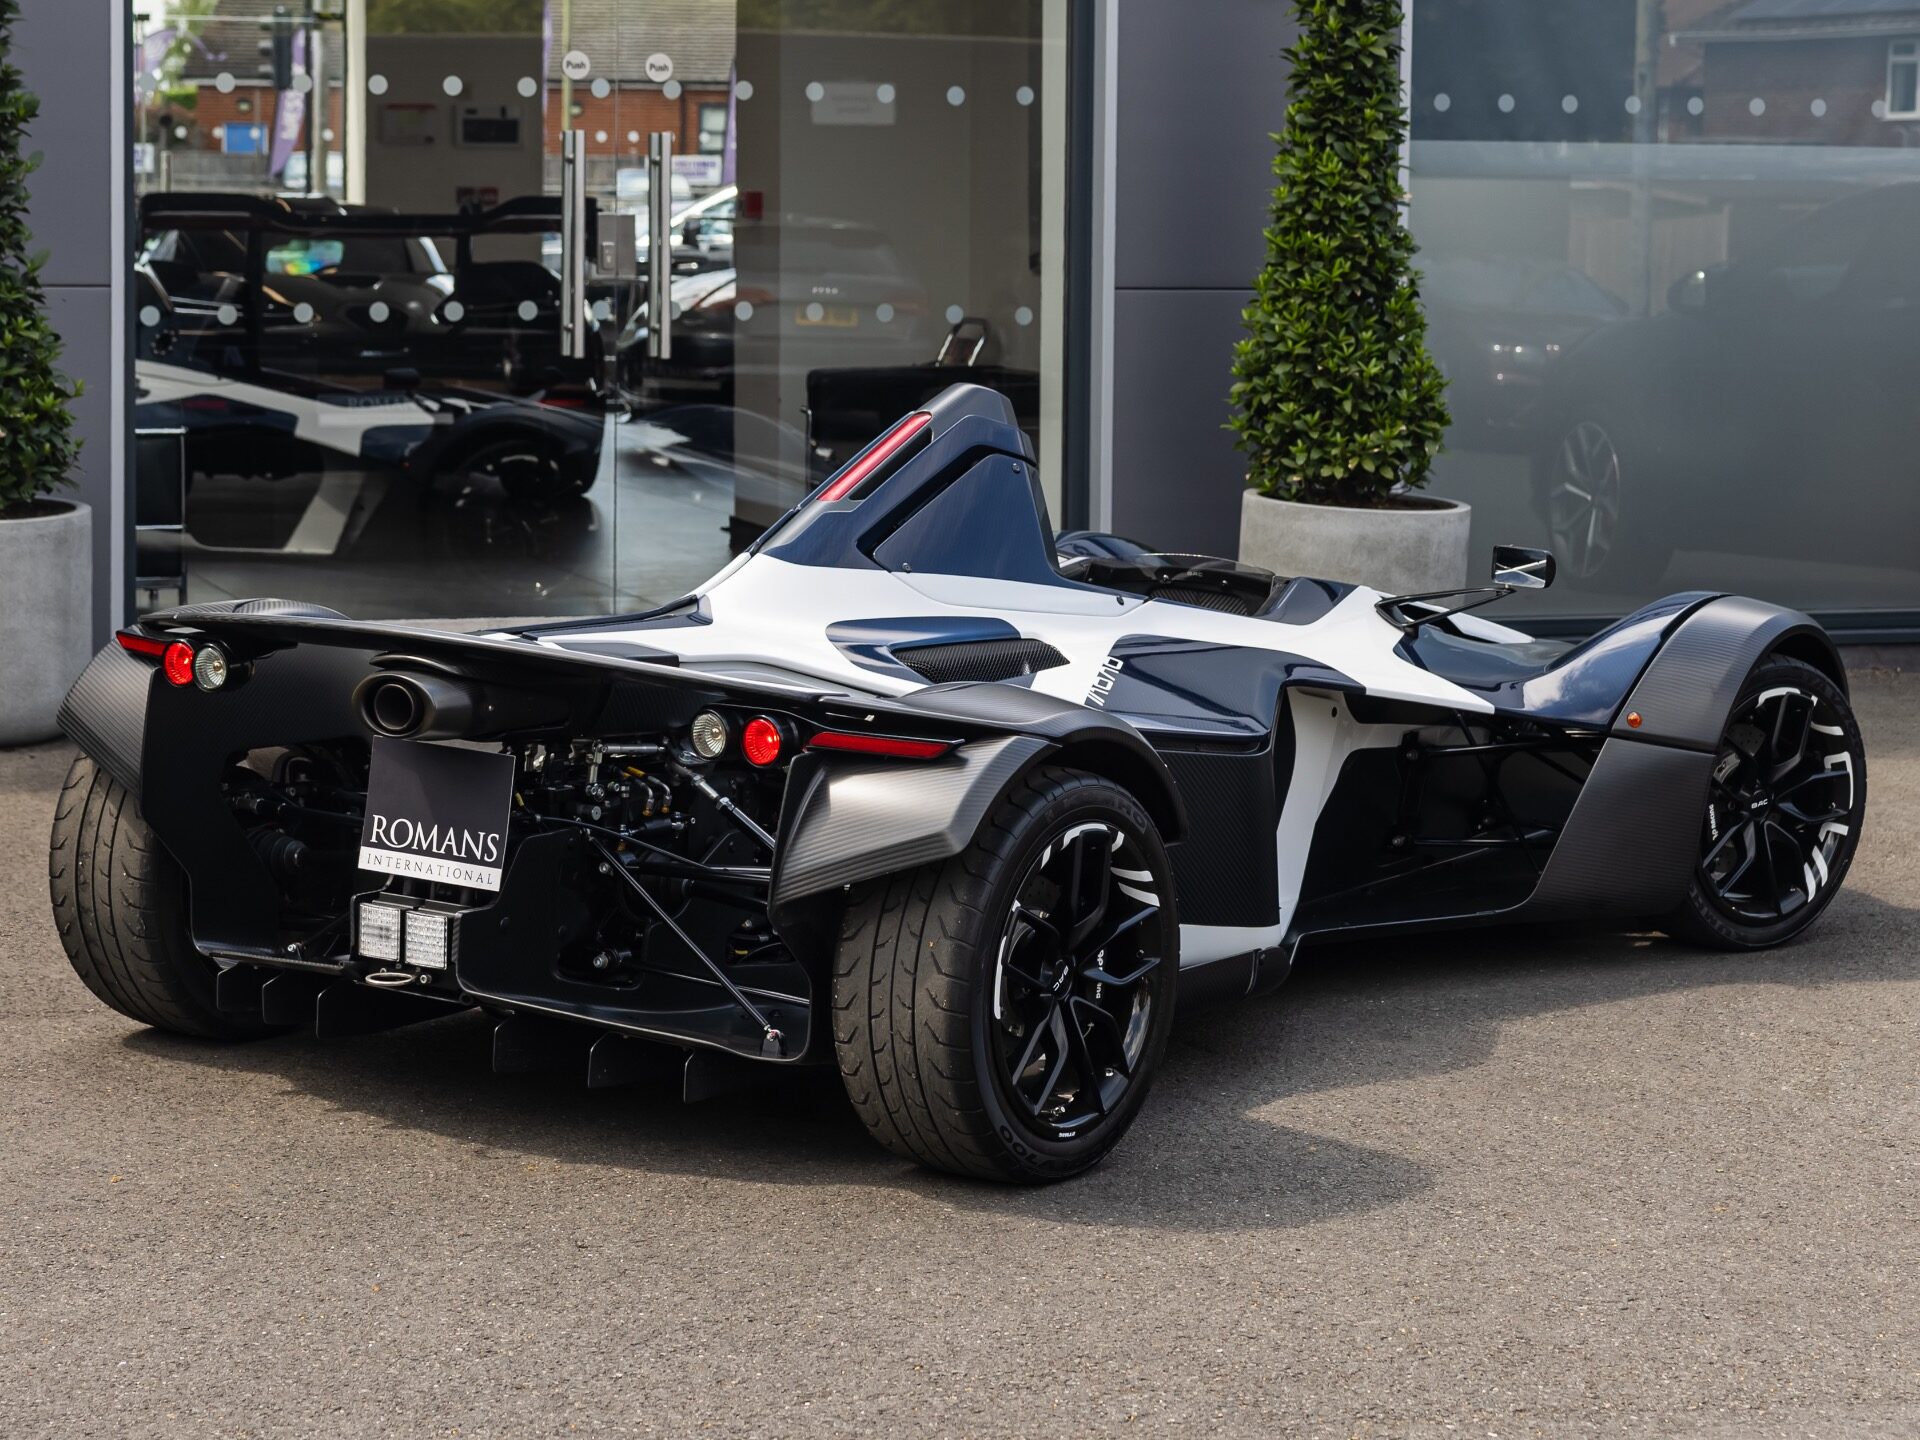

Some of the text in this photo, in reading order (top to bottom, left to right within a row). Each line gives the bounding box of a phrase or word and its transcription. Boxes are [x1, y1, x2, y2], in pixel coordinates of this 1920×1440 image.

[565, 61, 586, 70] Push
[649, 63, 669, 73] Push
[1751, 798, 1768, 809] BAC
[369, 814, 500, 862] ROMANS
[366, 853, 493, 885] INTERNATIONAL
[1052, 965, 1069, 991] BAC
